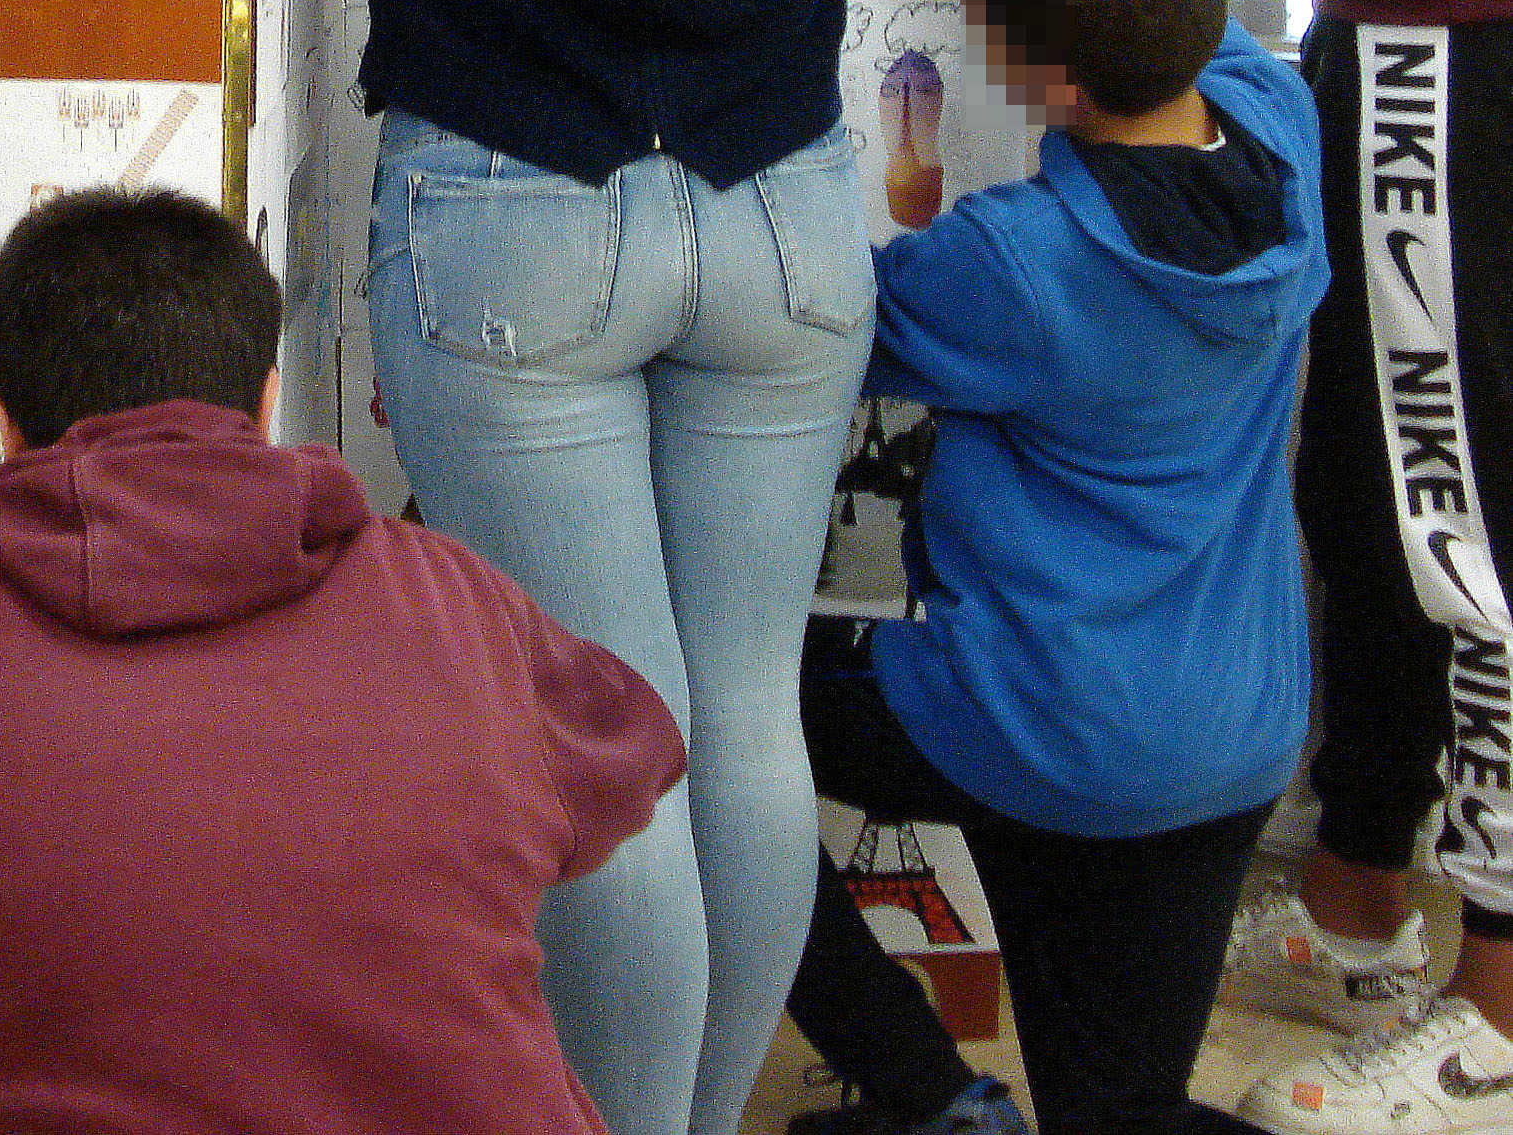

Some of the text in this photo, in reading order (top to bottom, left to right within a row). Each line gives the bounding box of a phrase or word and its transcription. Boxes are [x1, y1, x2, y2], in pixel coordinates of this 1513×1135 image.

[1373, 42, 1436, 216] NIKE
[1388, 349, 1469, 517] NIKE
[1454, 625, 1513, 789] NIKE
